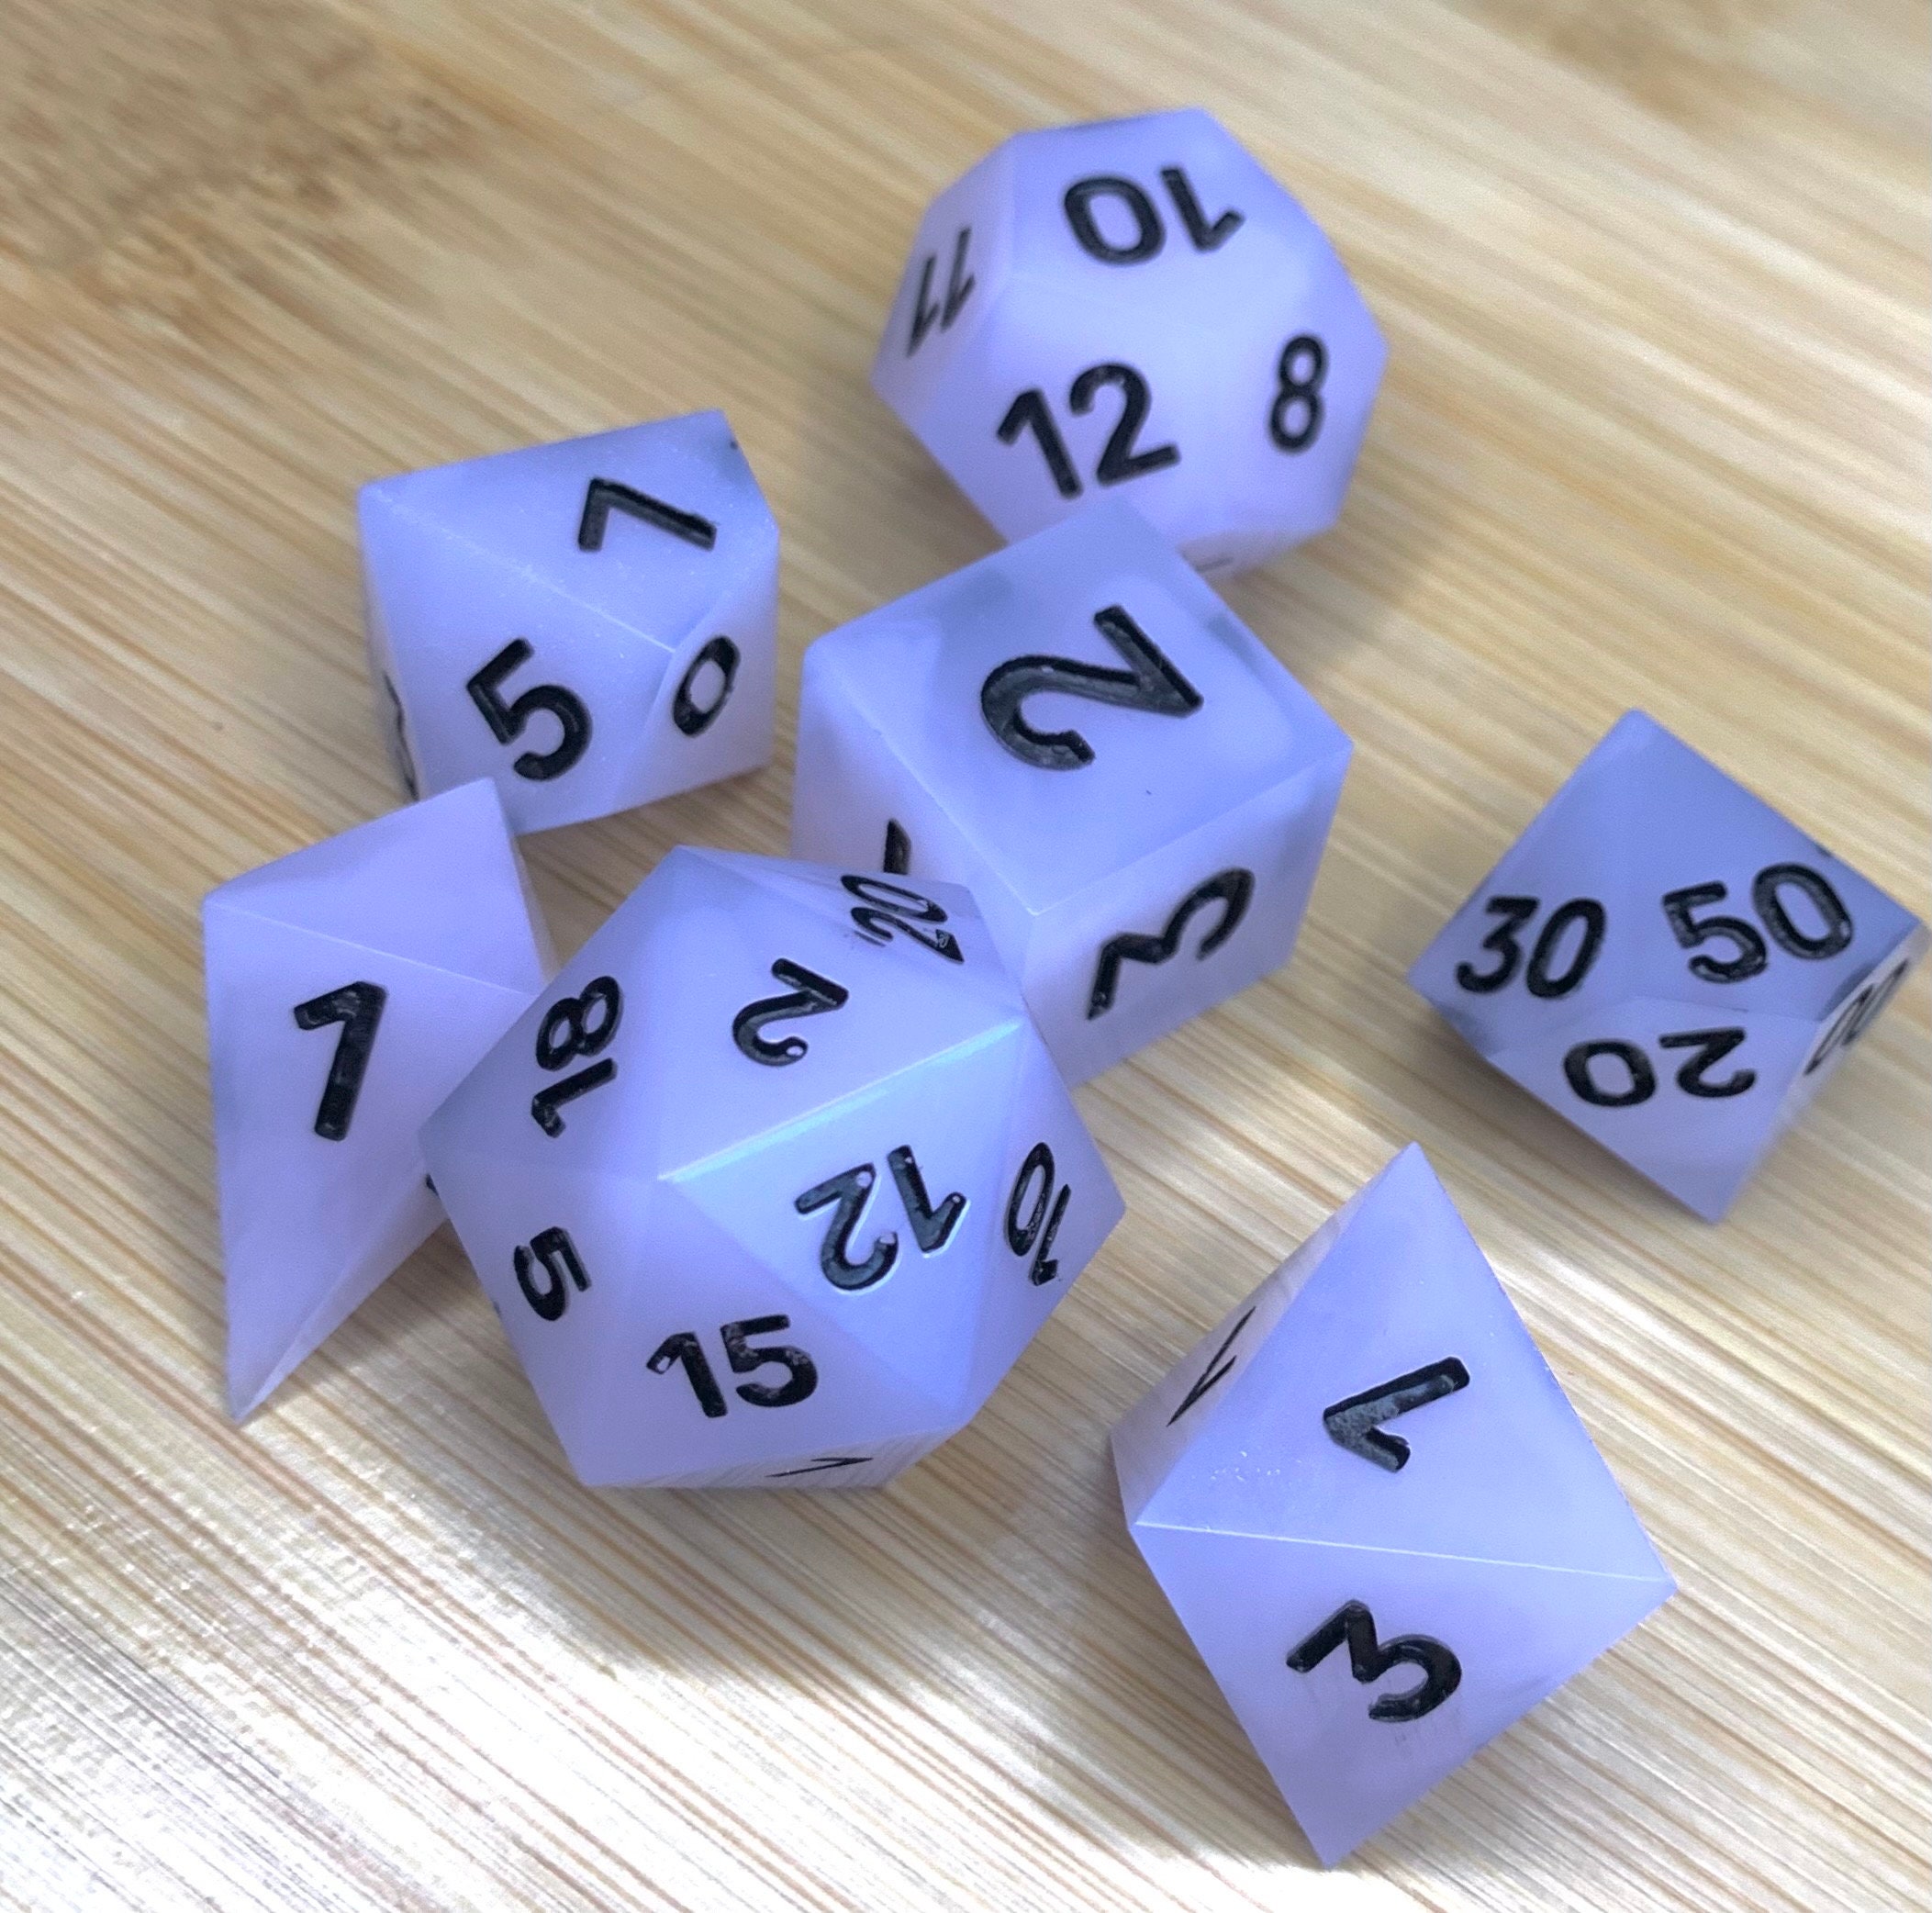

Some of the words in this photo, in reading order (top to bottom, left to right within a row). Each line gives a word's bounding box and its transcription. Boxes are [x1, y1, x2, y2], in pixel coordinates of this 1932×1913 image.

[1062, 163, 1245, 266] 10
[905, 226, 977, 358] 11
[995, 362, 1182, 499] 12
[1268, 334, 1329, 454] 8
[577, 476, 718, 552] 7
[465, 638, 593, 783] 5
[672, 635, 741, 739] 0
[980, 605, 1204, 772] 2
[840, 874, 966, 964] 20
[1085, 867, 1256, 1022] 3
[1454, 894, 1609, 1001] 30
[1659, 861, 1854, 986] 50
[294, 979, 387, 1142] 1
[530, 975, 625, 1139] 18
[732, 957, 849, 1068] 2
[1561, 1025, 1757, 1109] 20
[512, 1225, 593, 1323] 5
[794, 1144, 968, 1292] 12
[1004, 1141, 1072, 1287] 10
[645, 1314, 820, 1420] 15
[1323, 1355, 1471, 1472] 1
[1285, 1600, 1463, 1724] 3
